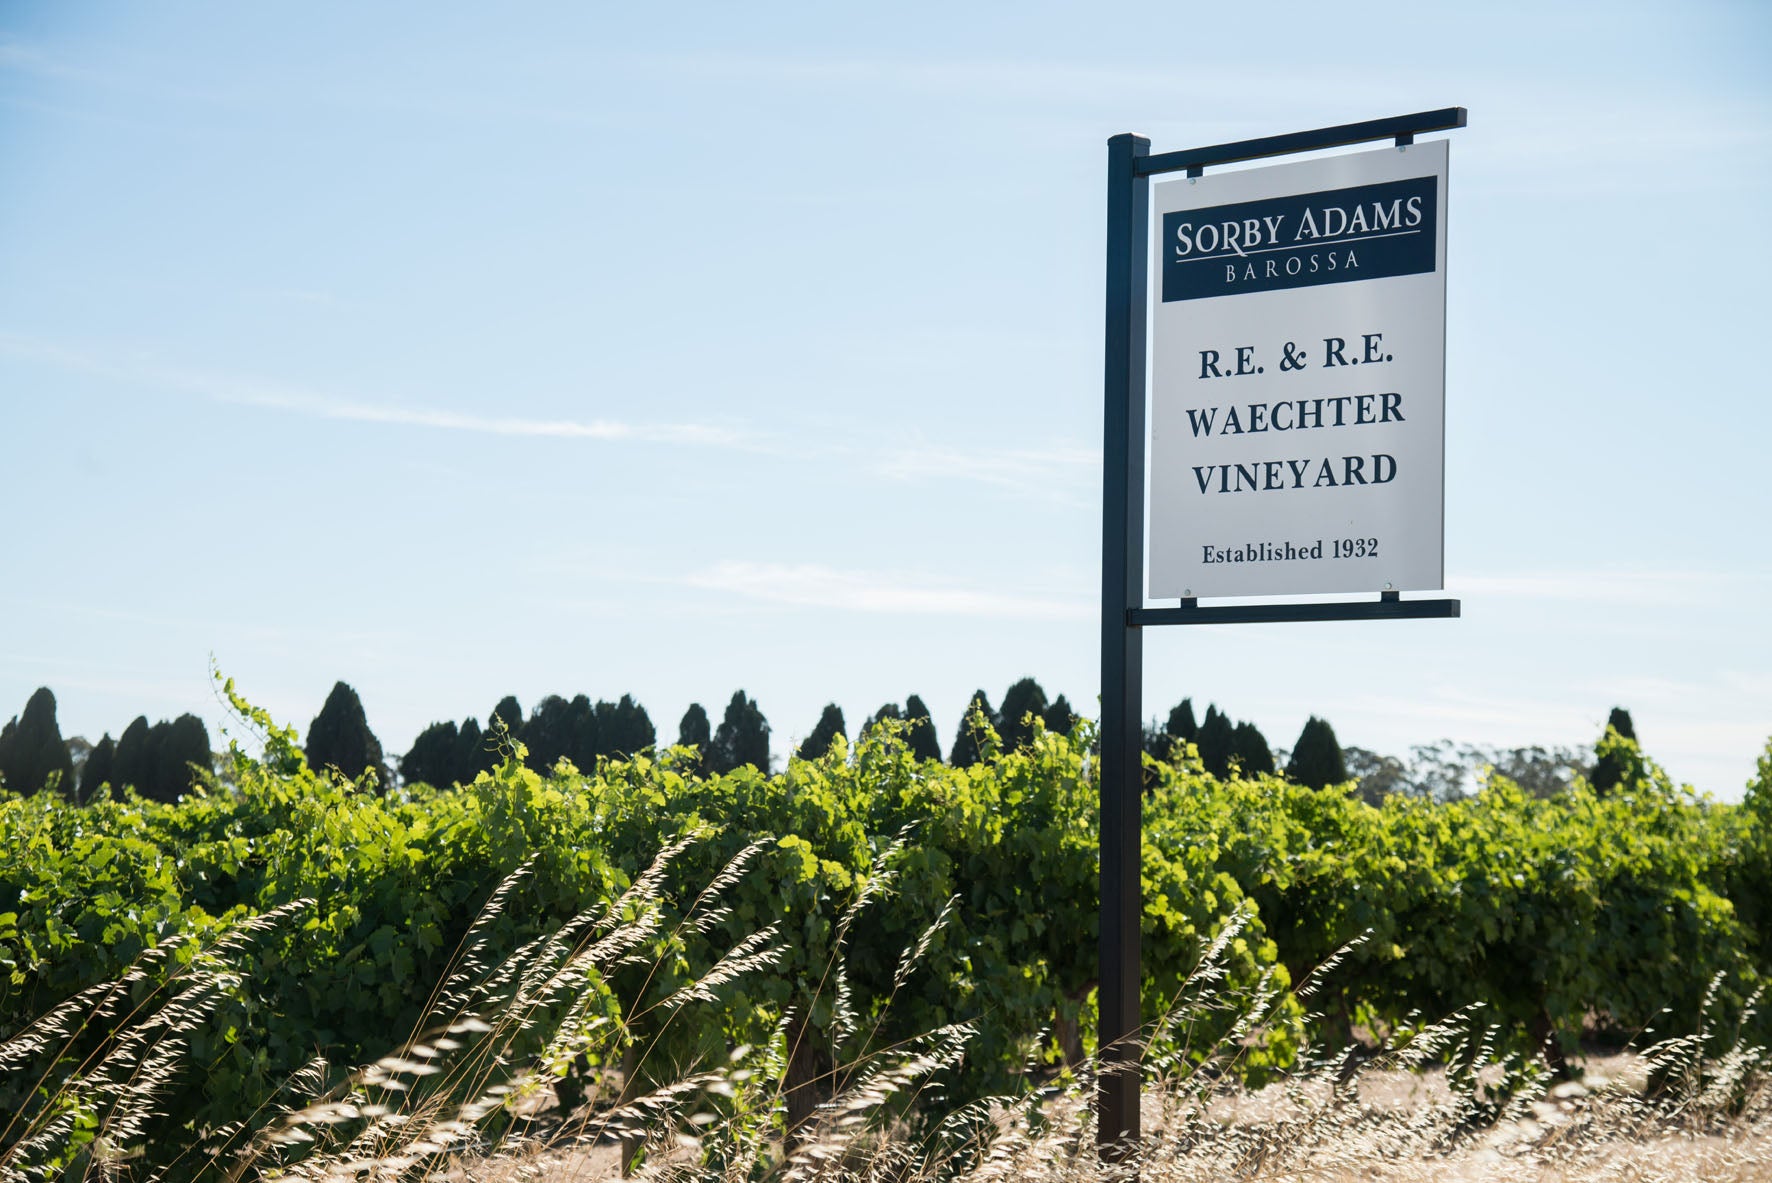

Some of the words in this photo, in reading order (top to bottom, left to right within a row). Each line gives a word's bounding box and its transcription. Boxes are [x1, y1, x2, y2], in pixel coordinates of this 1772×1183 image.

[1175, 215, 1286, 257] SORBY
[1294, 196, 1422, 241] ADAMS
[1225, 250, 1359, 283] BAROSSA
[1198, 346, 1264, 379] R.E.
[1279, 341, 1307, 372] &
[1322, 333, 1393, 368] R.E.
[1185, 392, 1406, 438] WAECHTER
[1192, 454, 1397, 495] VINEYARD
[1202, 540, 1323, 564] Established
[1332, 537, 1379, 559] 1932
